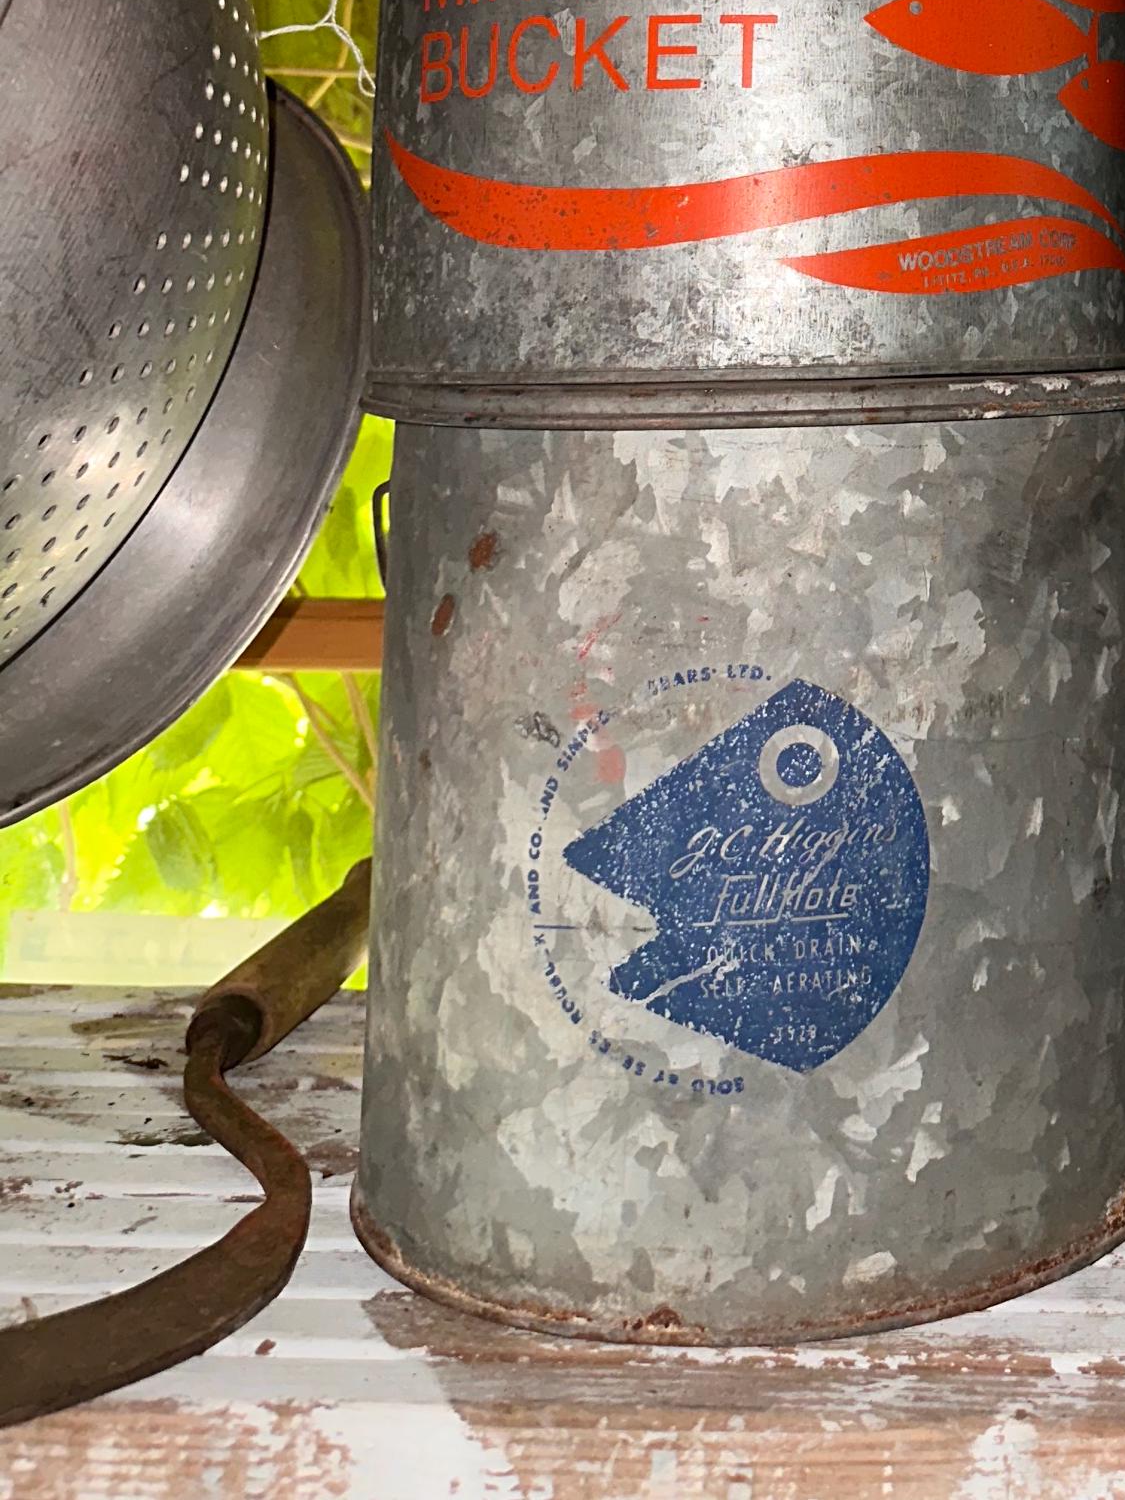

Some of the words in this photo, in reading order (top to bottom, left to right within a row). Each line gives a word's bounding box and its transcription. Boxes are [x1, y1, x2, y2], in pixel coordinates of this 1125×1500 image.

[421, 12, 778, 104] BUCKET
[898, 231, 1034, 272] WOODSTREAM
[727, 663, 772, 682] LTD.
[528, 826, 543, 861] CO.
[527, 868, 541, 915] AND
[707, 942, 776, 964] QUICK
[795, 932, 862, 960] DRAIN
[533, 932, 583, 1025] ROEBUK
[772, 965, 873, 995] AERATING
[588, 1030, 646, 1076] SERS
[691, 1076, 745, 1095] SOLD
